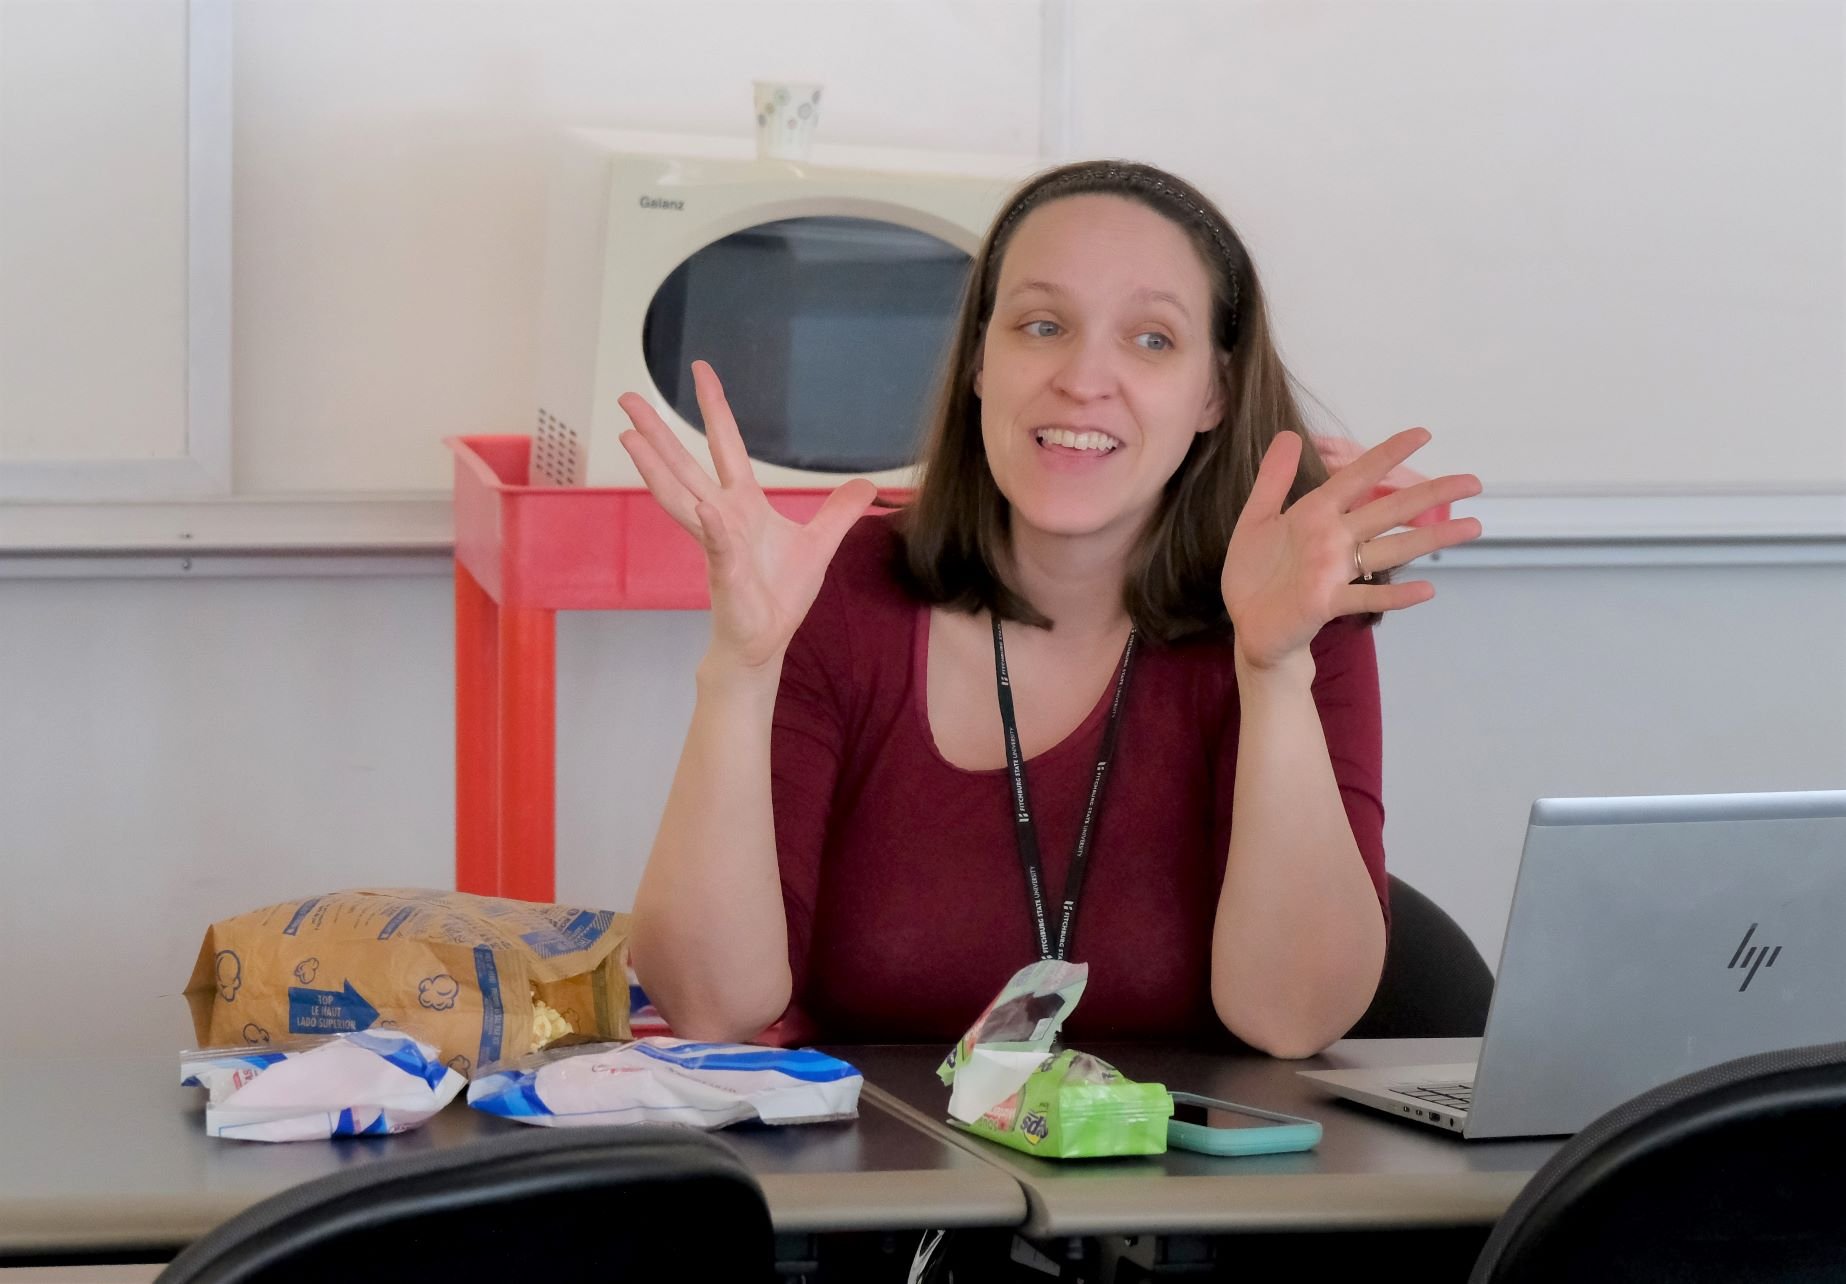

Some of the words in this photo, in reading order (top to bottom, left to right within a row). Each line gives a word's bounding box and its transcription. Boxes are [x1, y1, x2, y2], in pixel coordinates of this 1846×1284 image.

[639, 195, 686, 211] Galanz
[1009, 728, 1018, 759] UNIVERSITY
[1013, 760, 1021, 777] STATE
[1015, 777, 1026, 812] FITCHBURG
[1089, 772, 1102, 806] FITCHBURG
[1084, 807, 1093, 824] STATE
[1076, 825, 1089, 857] UNIVERSITY
[1029, 866, 1041, 899] UNIVERSITY
[1034, 899, 1044, 918] STATE
[1037, 918, 1049, 954] FITCHBURG
[1058, 911, 1070, 948] FITCHBURG
[1727, 922, 1783, 992] hp
[310, 1006, 320, 1016] LE
[321, 1006, 342, 1018] HAUT
[317, 994, 334, 1005] TOP
[296, 1016, 317, 1028] LADO
